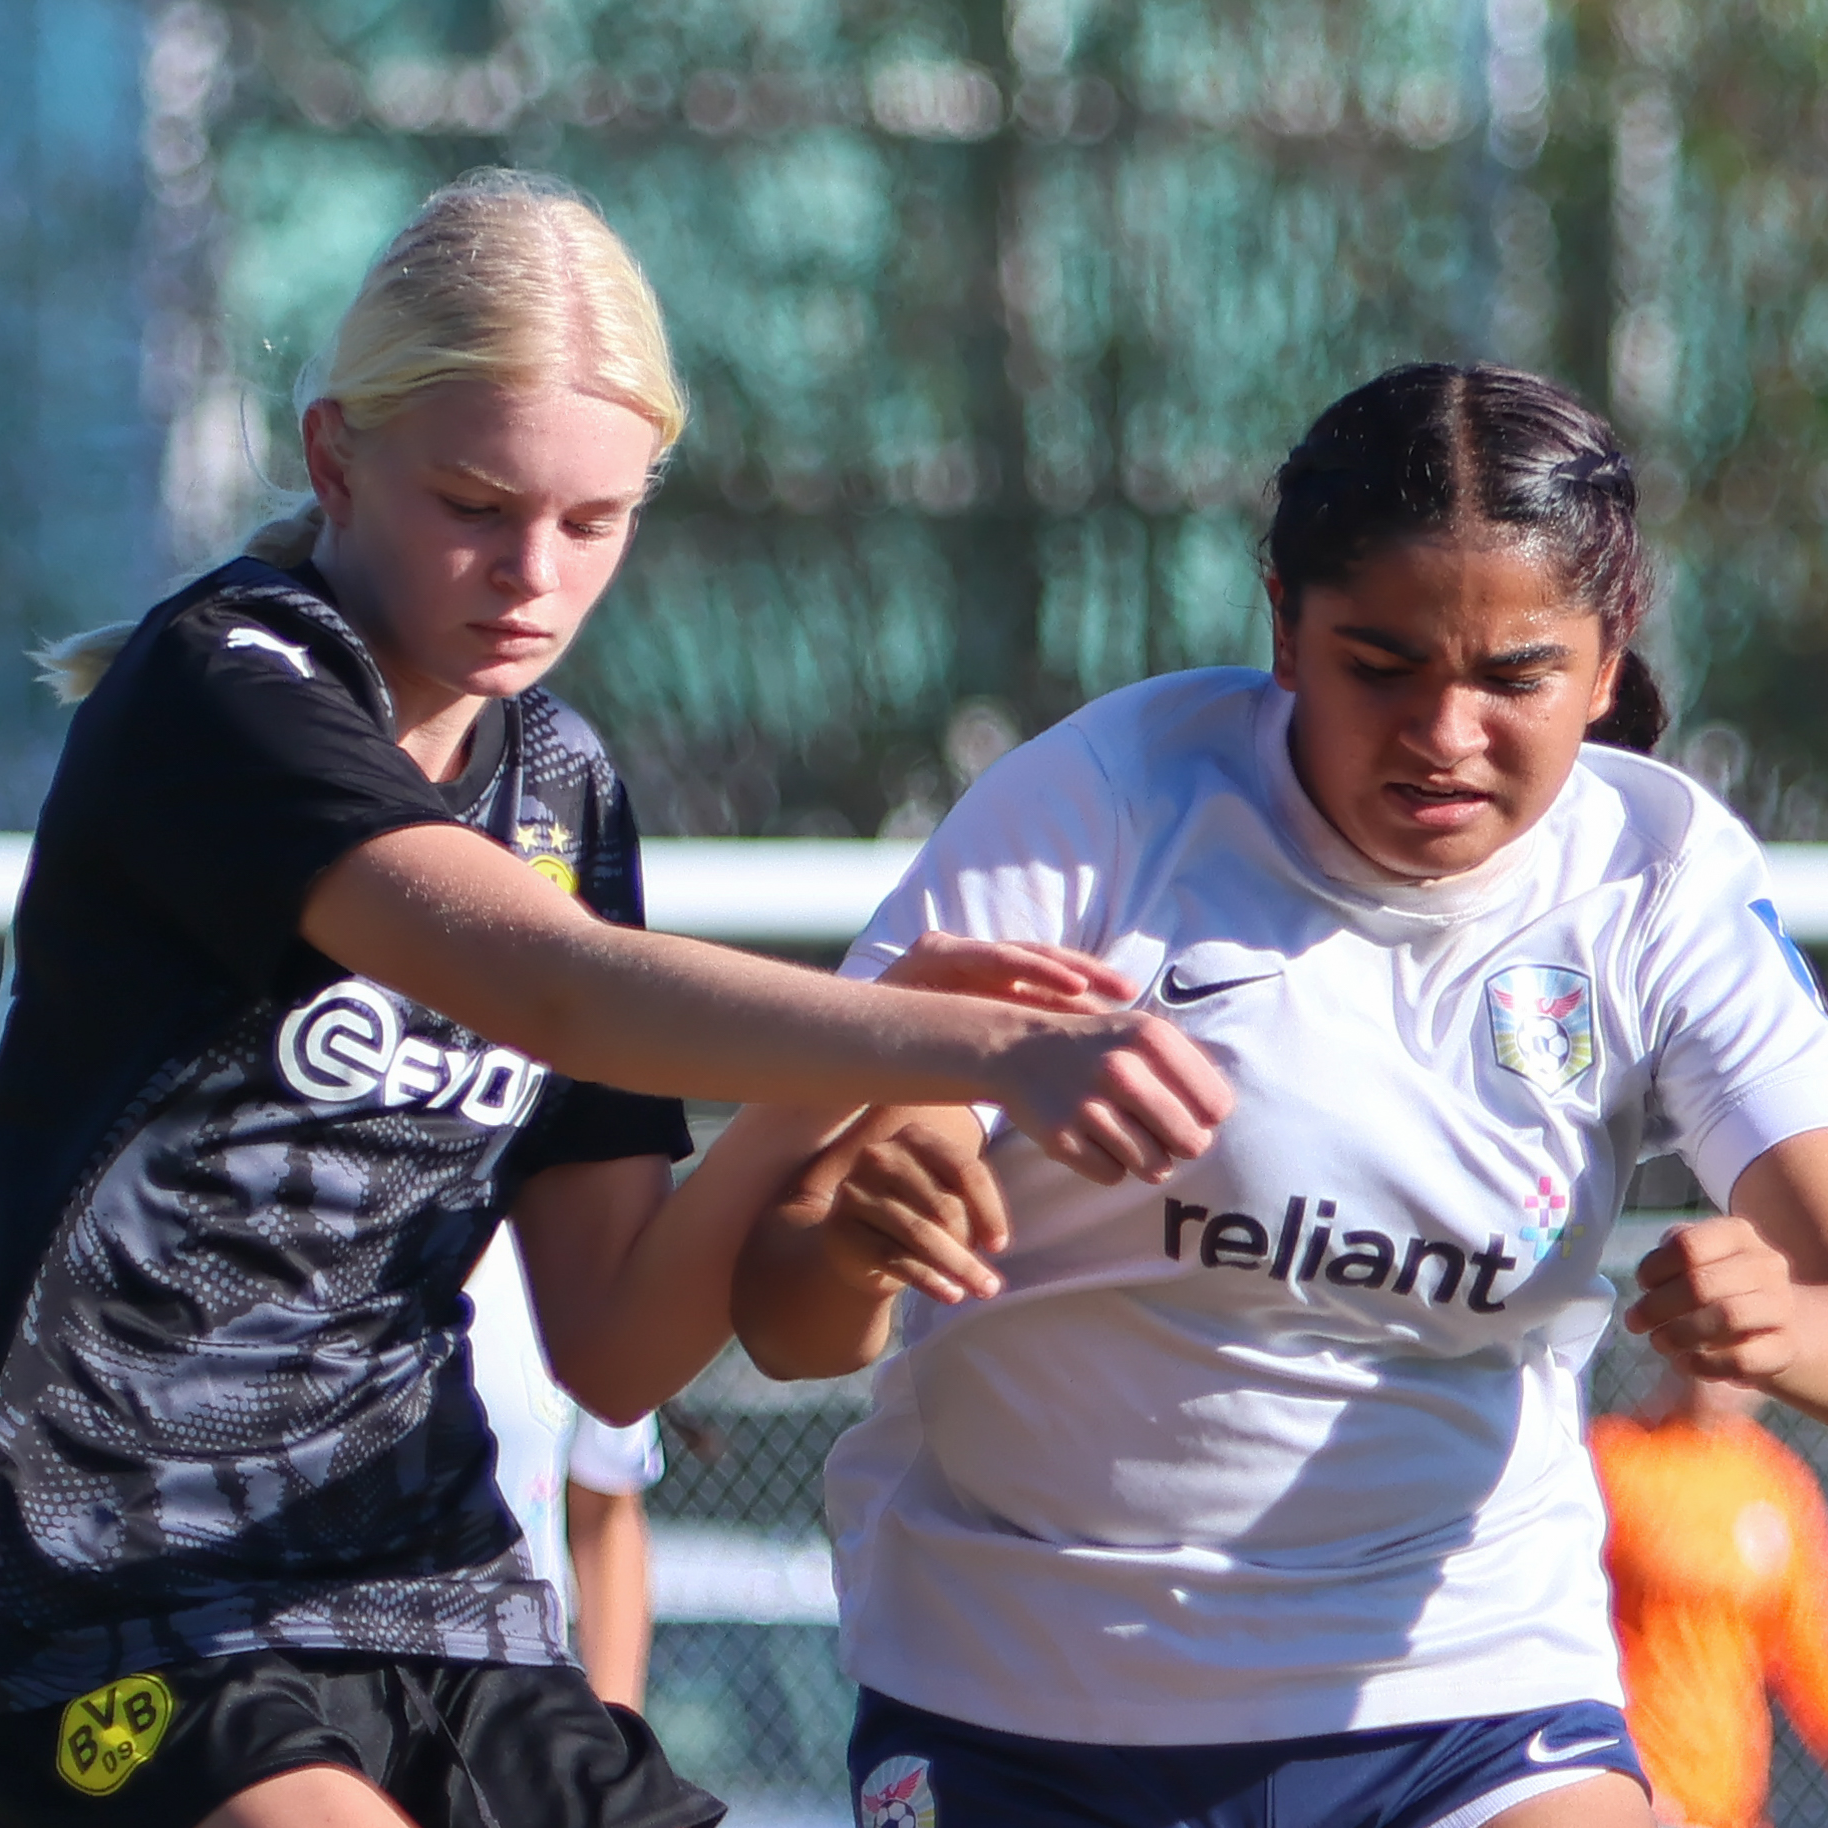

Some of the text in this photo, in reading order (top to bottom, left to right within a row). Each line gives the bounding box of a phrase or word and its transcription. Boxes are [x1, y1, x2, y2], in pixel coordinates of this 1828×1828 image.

[1163, 1194, 1517, 1315] reliant
[68, 1686, 157, 1775] BVB
[102, 1741, 133, 1774] 09
